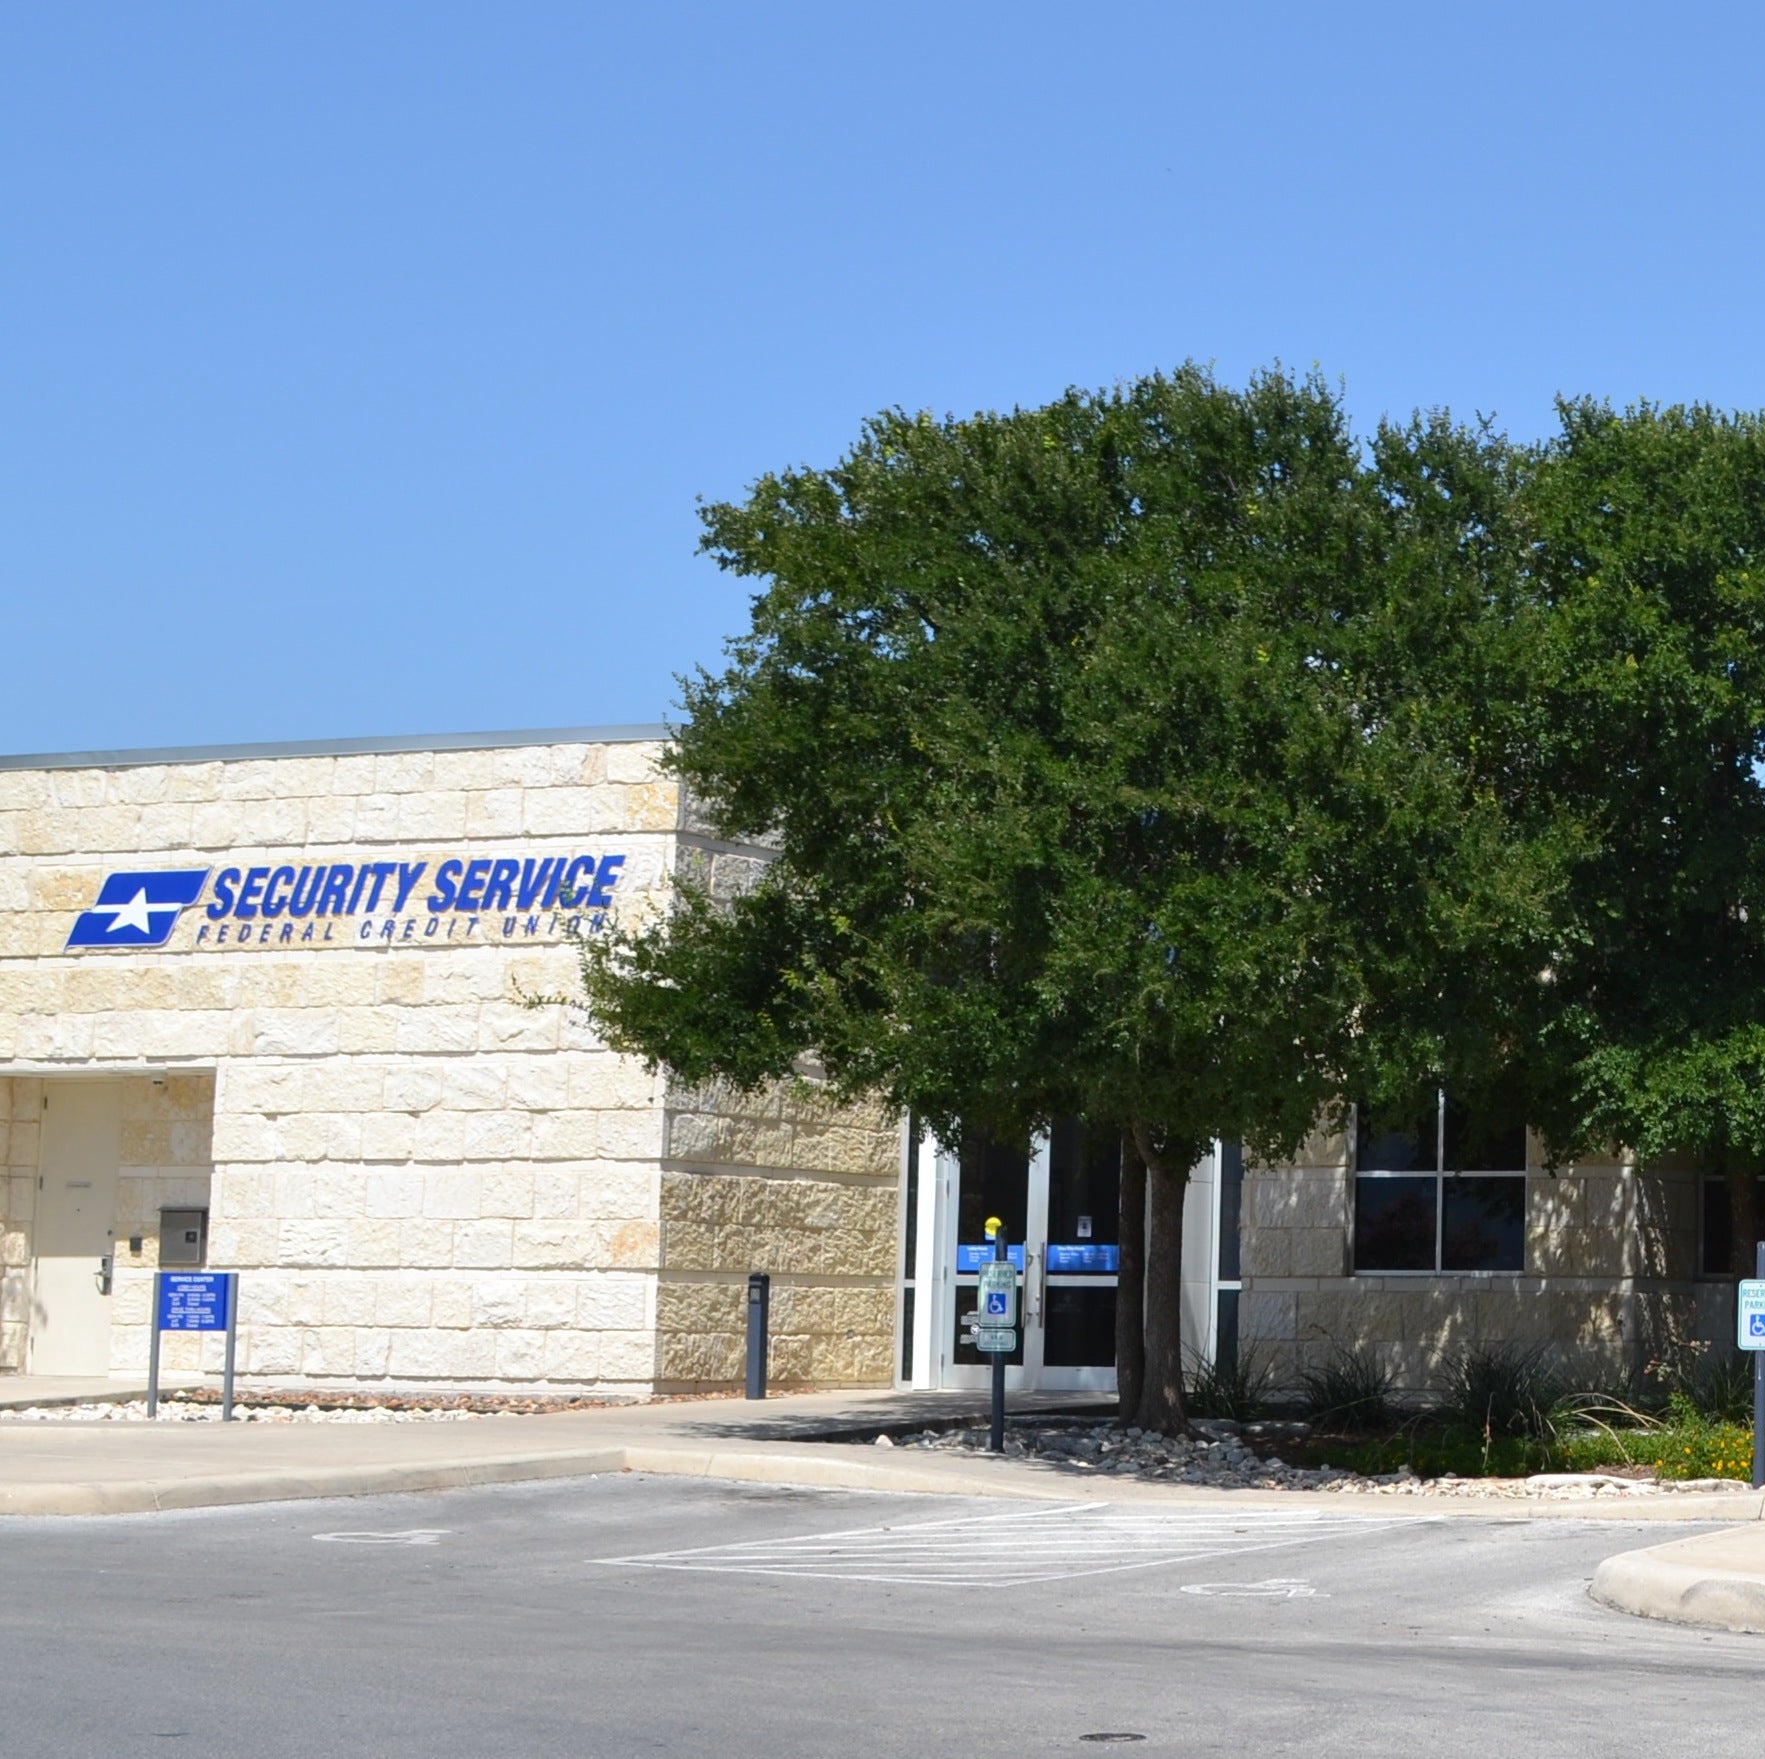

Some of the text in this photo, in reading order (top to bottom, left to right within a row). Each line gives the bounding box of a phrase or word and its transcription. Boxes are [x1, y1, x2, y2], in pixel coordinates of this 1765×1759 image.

[206, 855, 626, 920] SECURITY SERVICE
[196, 911, 608, 945] FEDERAL CREDIT UNION
